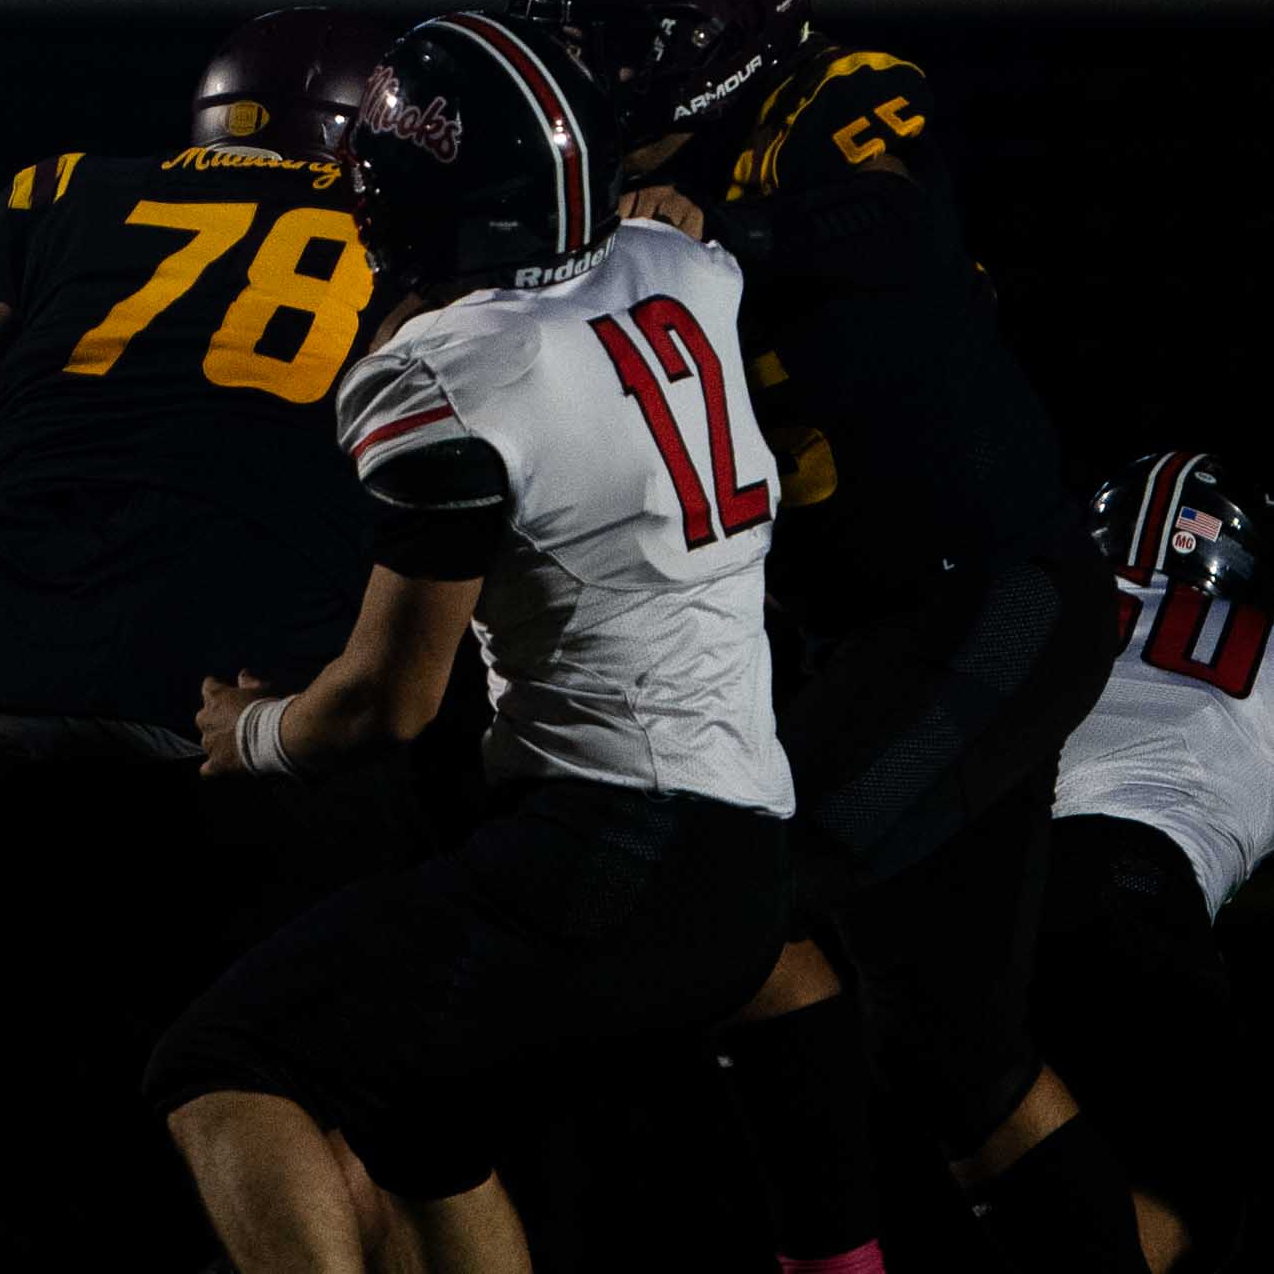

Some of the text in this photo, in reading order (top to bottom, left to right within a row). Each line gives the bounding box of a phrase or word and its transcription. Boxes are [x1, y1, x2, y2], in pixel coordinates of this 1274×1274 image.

[672, 54, 764, 122] ARMOUR
[60, 198, 376, 405] 78
[587, 293, 774, 552] 12
